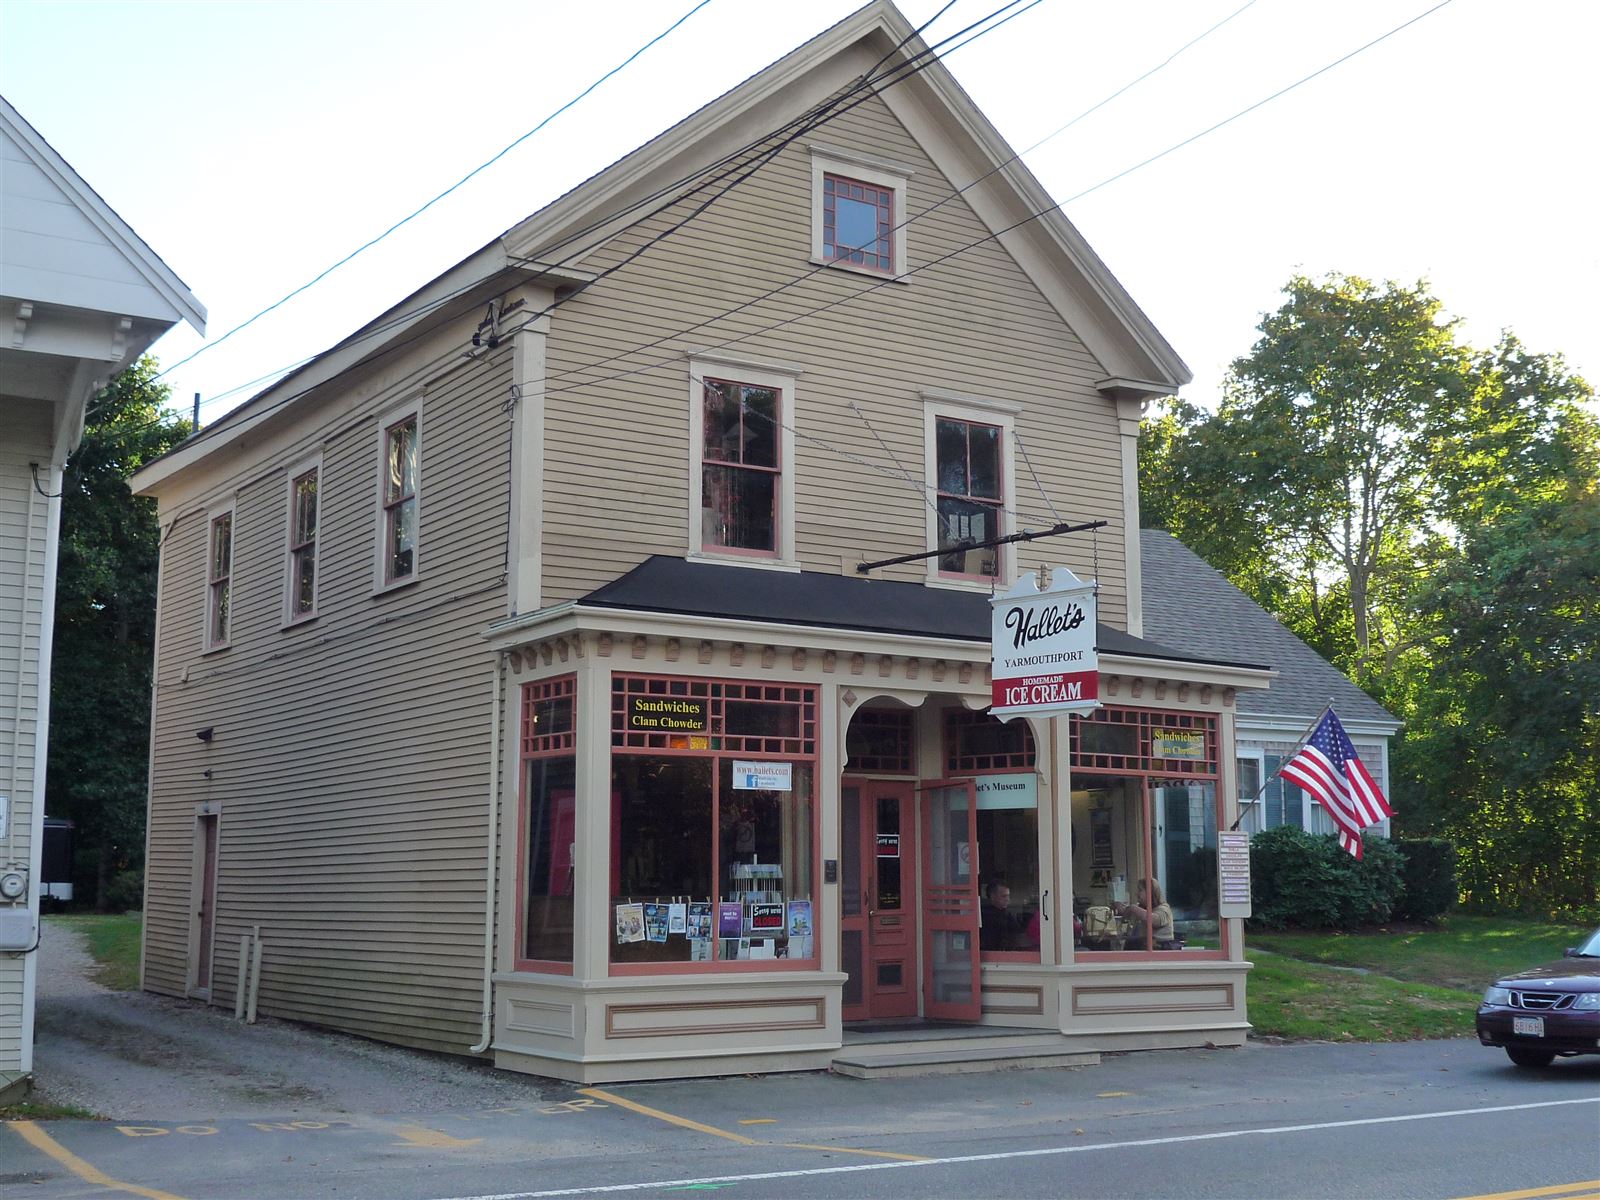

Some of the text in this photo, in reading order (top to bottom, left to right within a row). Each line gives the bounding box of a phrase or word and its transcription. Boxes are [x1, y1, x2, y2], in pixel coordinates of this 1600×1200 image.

[1005, 603, 1085, 650] Hallet's
[1005, 650, 1084, 668] YARMOUTHPORT
[1022, 676, 1063, 686] HOMEMADE
[1005, 682, 1082, 705] ICE CREAM
[635, 698, 700, 714] Sandwiches
[632, 715, 703, 729] Clam Chowder
[992, 782, 1026, 791] Museum
[115, 1125, 219, 1137] DO
